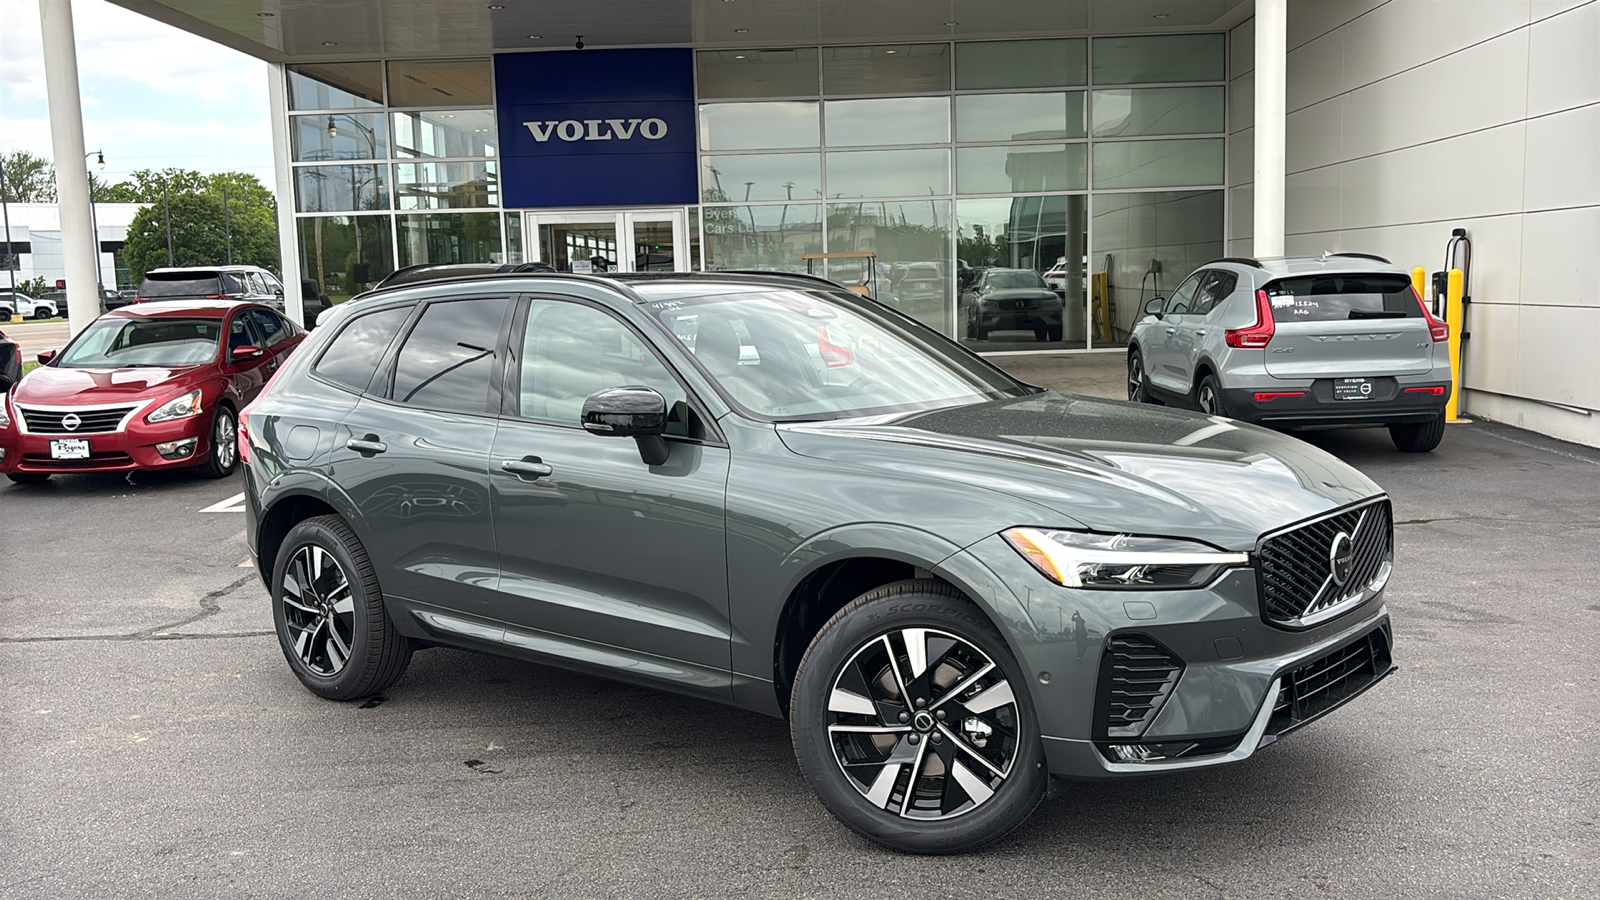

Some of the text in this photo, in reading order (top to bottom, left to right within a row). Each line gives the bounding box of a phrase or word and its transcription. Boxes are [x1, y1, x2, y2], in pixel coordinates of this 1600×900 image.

[522, 118, 668, 142] VOLVO
[705, 208, 738, 221] Byers
[705, 223, 734, 234] Cars
[886, 604, 989, 629] SCORPION
